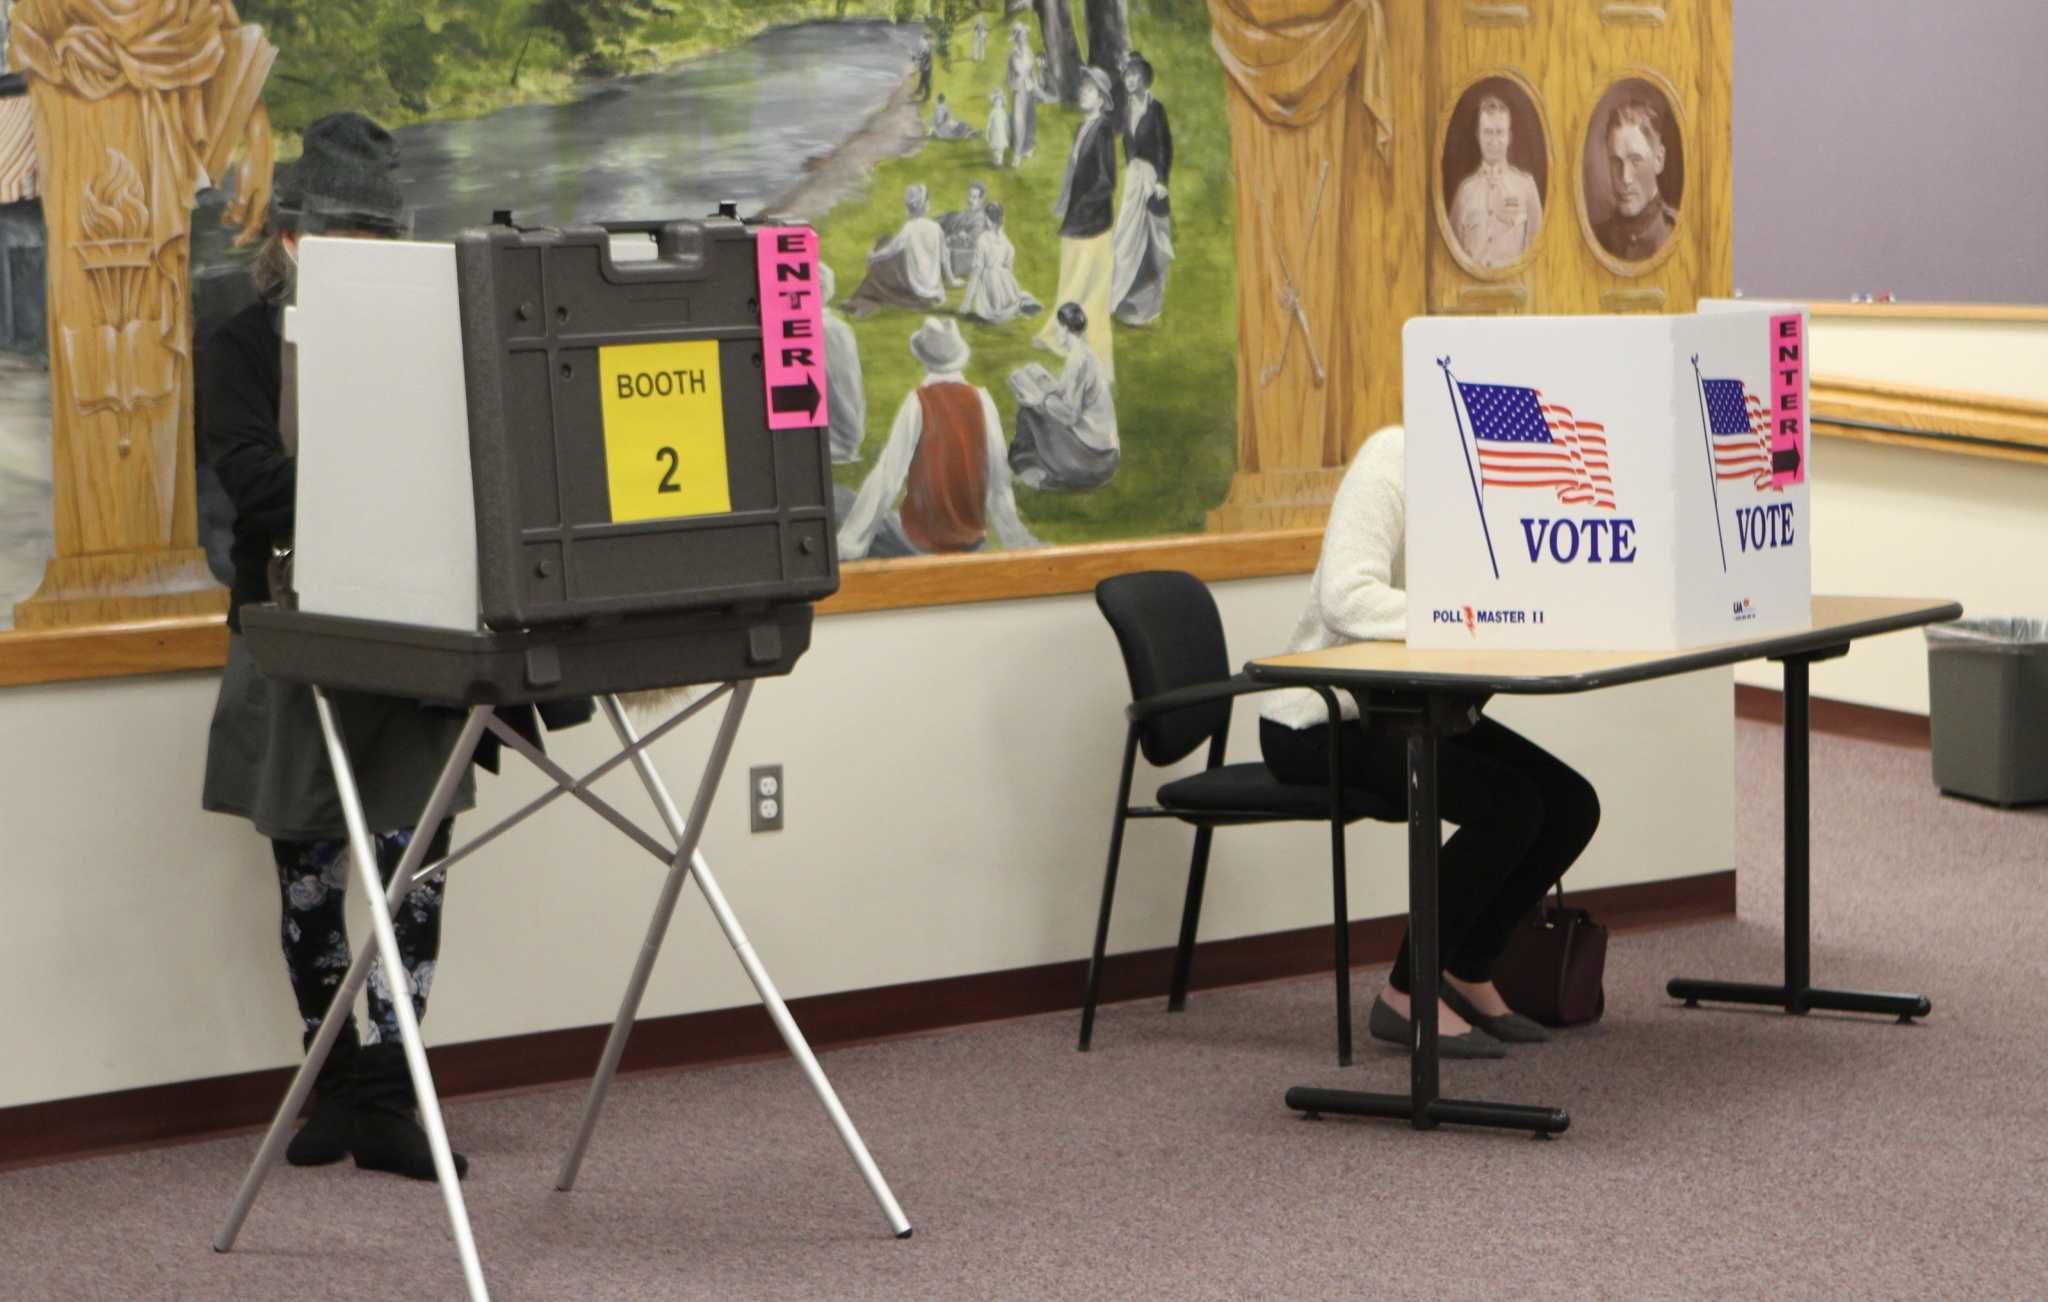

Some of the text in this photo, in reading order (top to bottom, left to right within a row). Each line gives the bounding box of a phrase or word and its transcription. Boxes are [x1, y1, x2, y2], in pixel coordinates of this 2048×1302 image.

[776, 233, 816, 368] ENTER
[616, 369, 706, 399] BOOTH
[1779, 320, 1799, 436] ENTER
[656, 446, 681, 494] 2
[1520, 518, 1637, 563] VOTE
[1736, 503, 1794, 553] VOTE
[1433, 610, 1463, 623] POLL
[1477, 610, 1525, 624] MASTER
